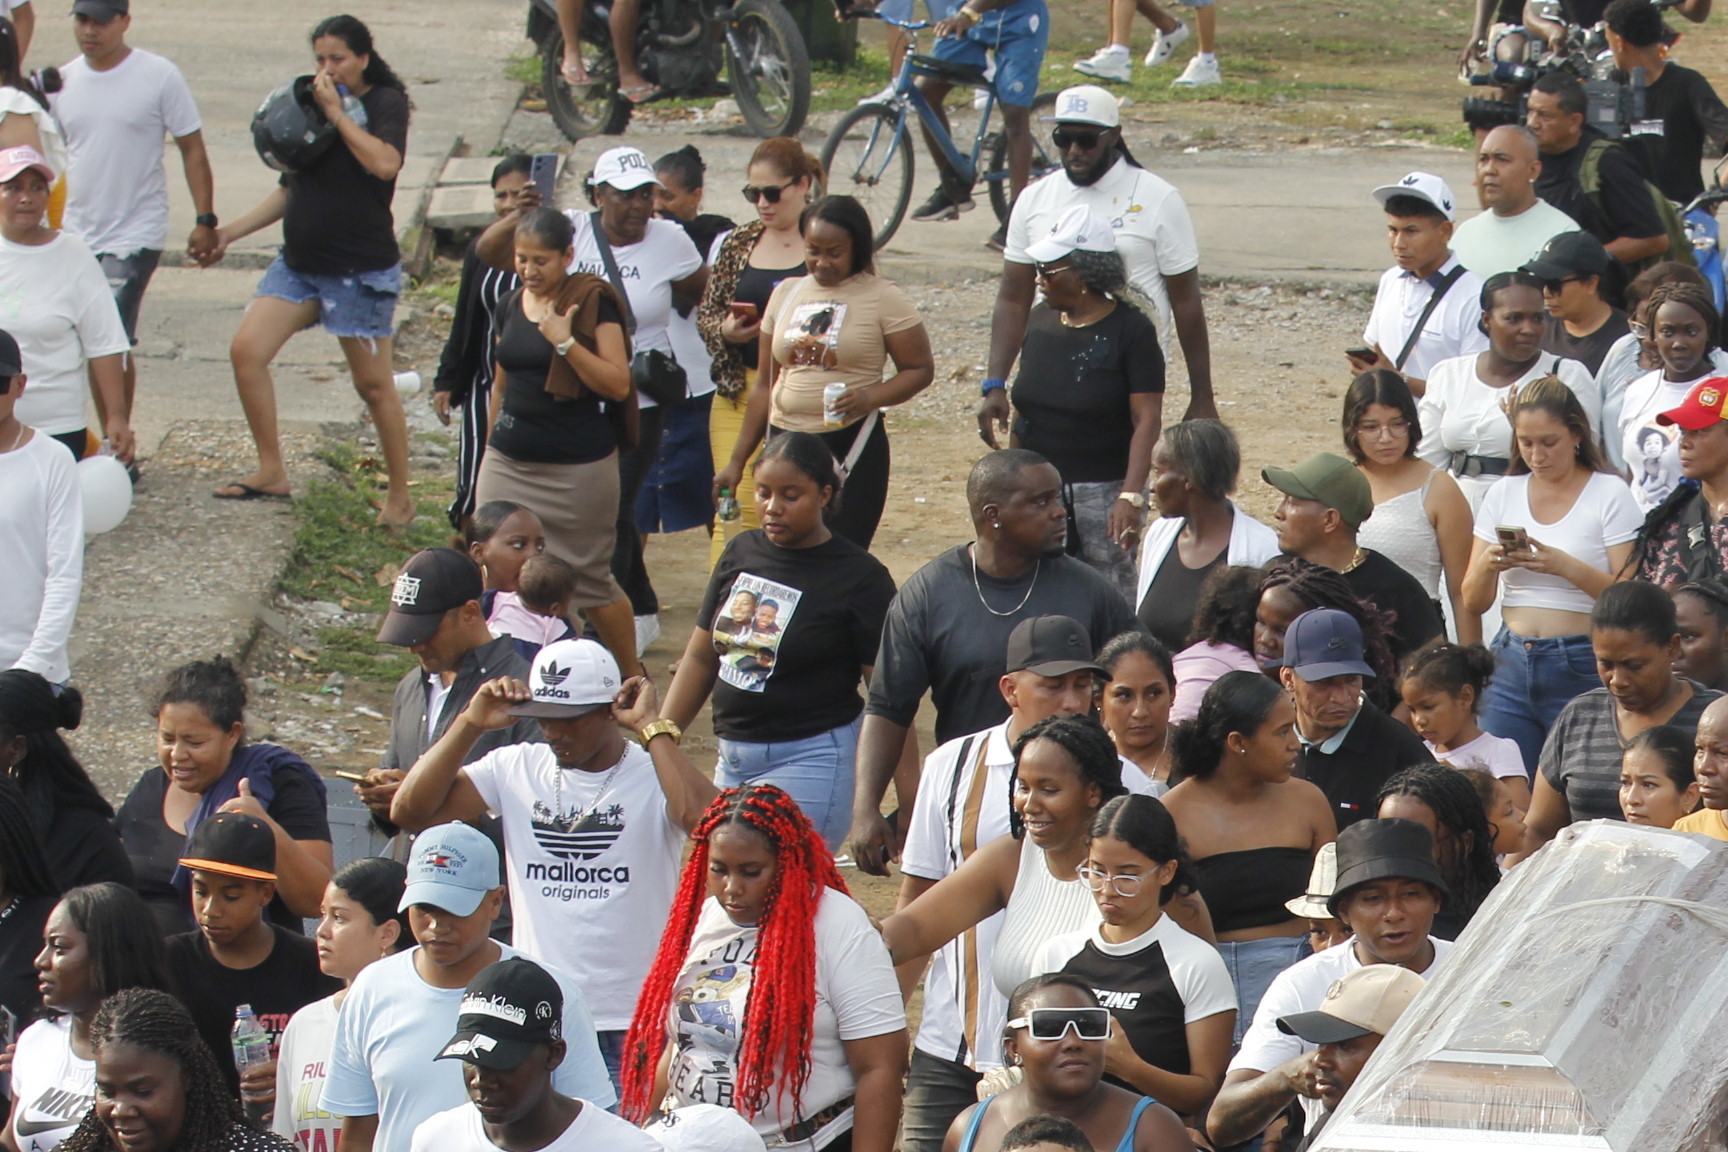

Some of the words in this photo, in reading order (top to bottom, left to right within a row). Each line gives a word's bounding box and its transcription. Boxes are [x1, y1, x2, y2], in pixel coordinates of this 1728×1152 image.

[534, 686, 571, 699] adidas
[526, 862, 630, 884] mallorca
[541, 884, 611, 902] originals
